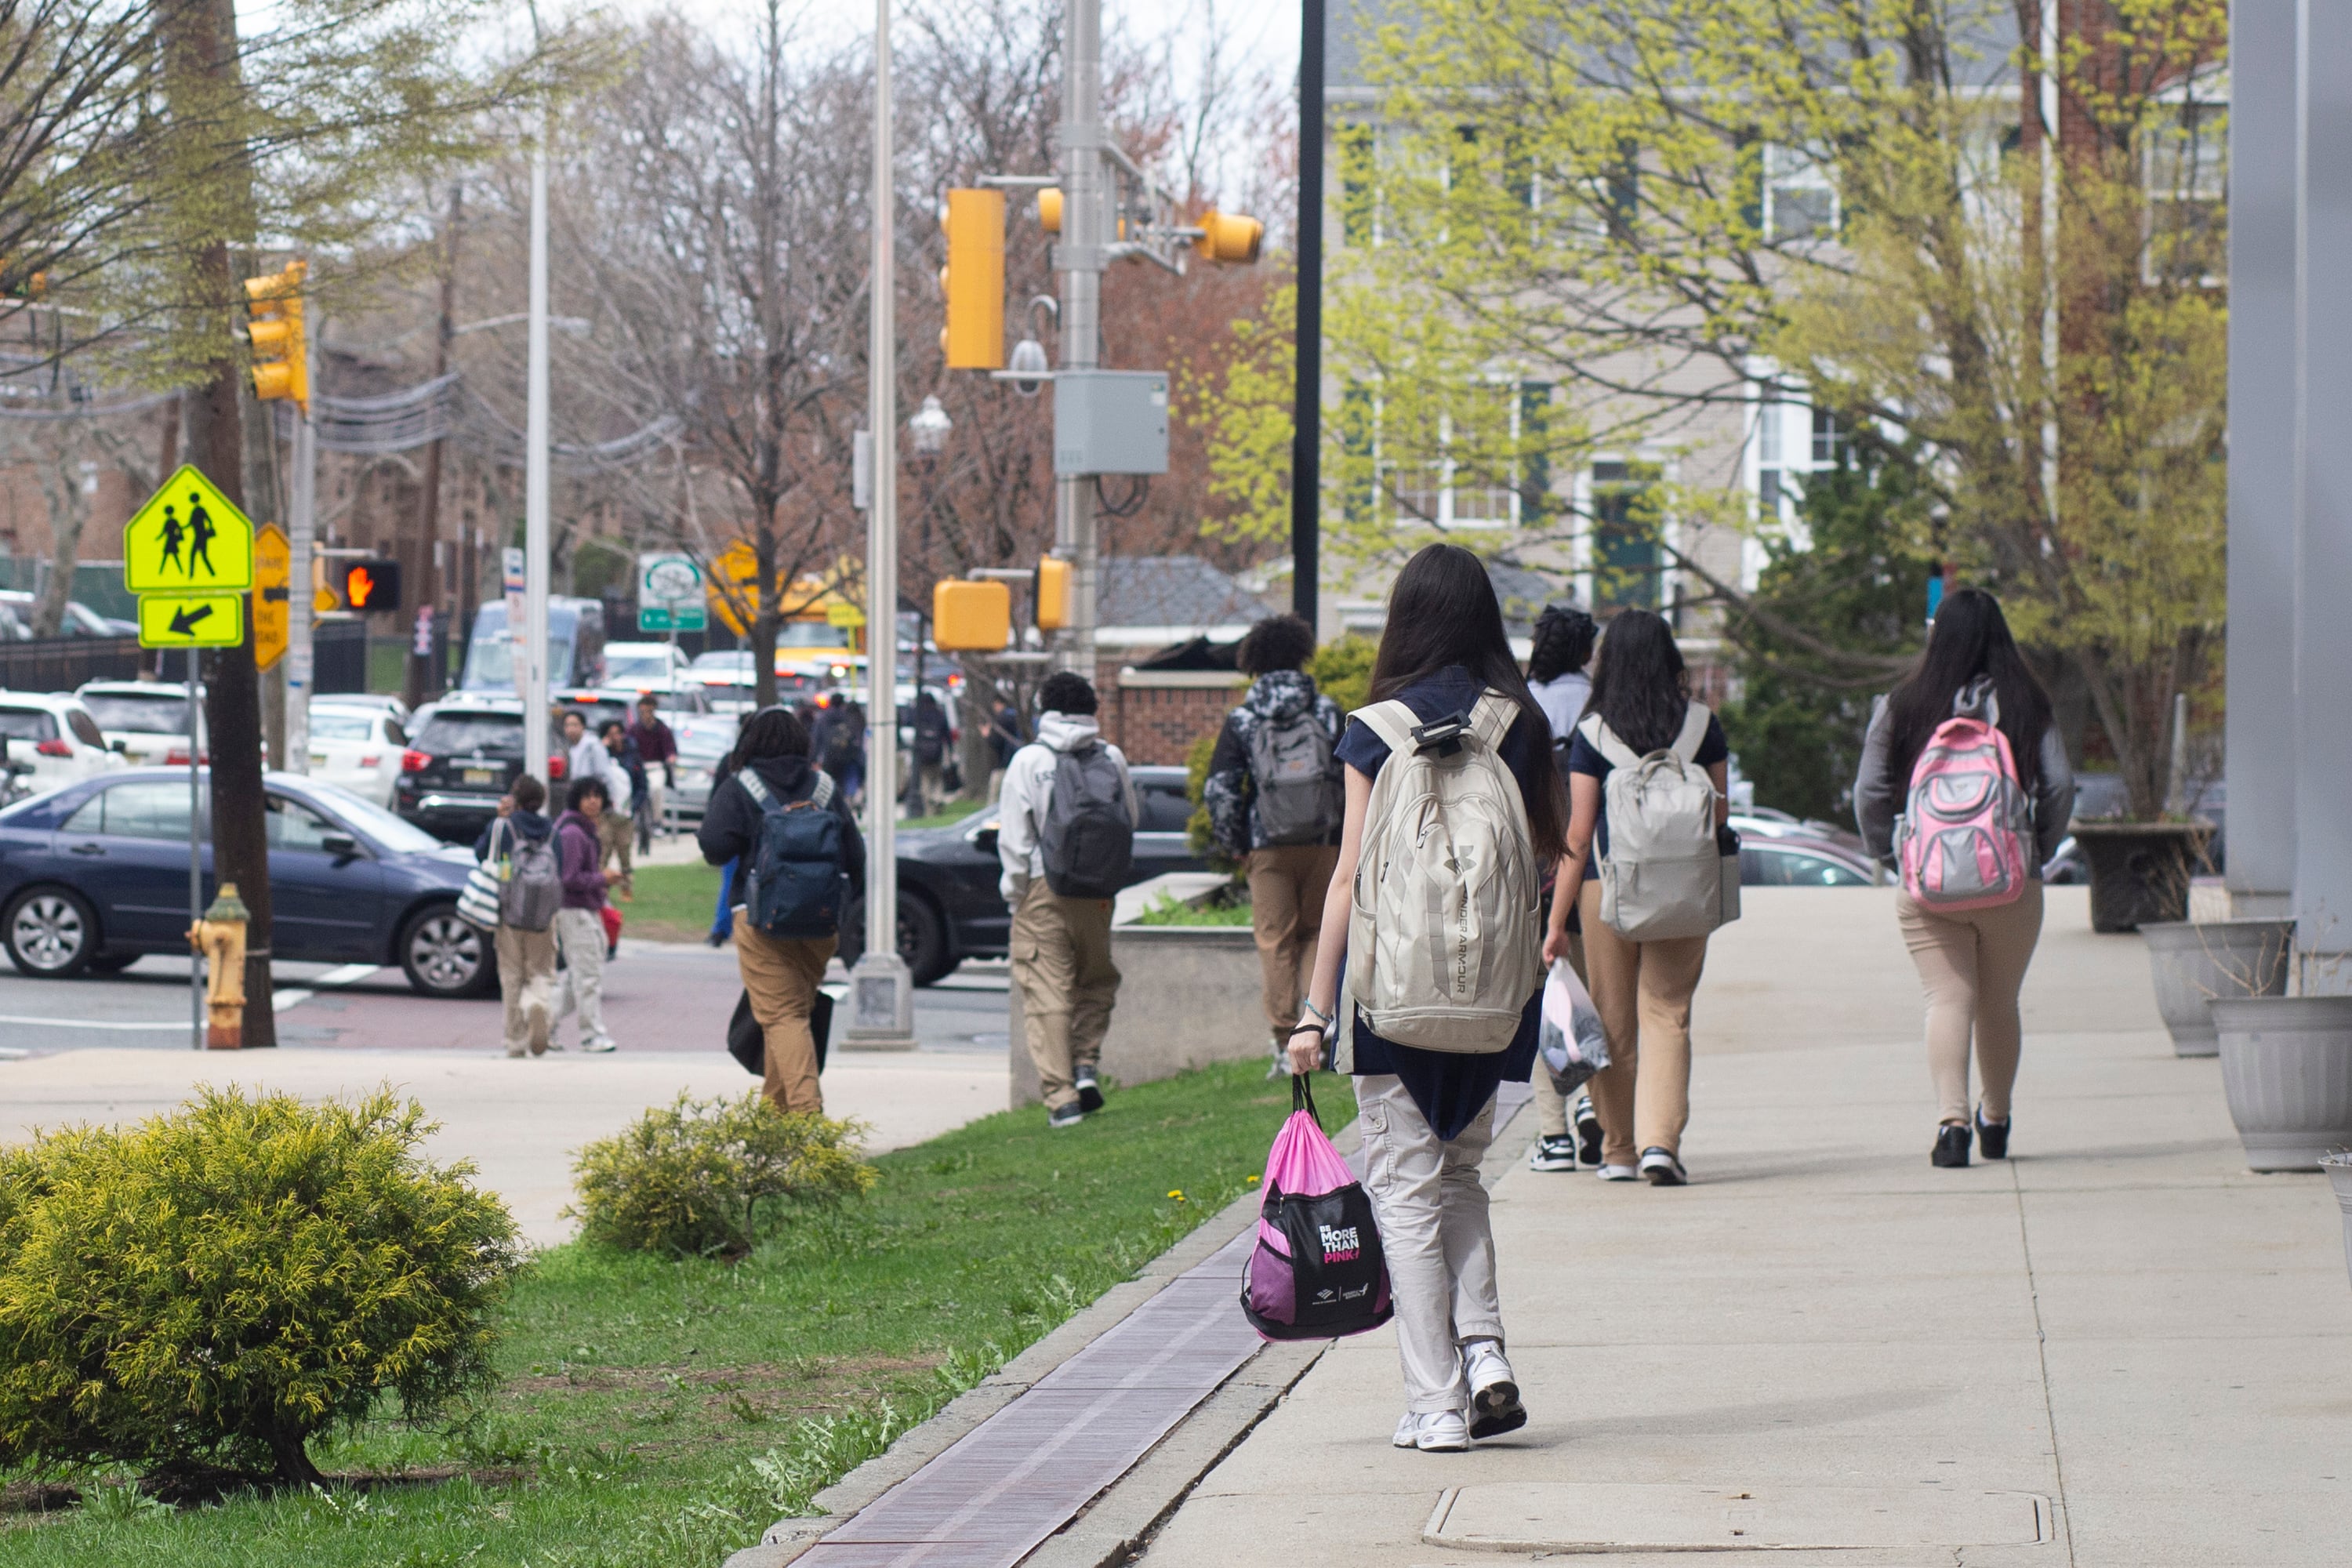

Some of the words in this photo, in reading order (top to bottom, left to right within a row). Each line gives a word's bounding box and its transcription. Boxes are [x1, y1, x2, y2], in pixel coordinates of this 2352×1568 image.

[1459, 890, 1468, 933] UNDER
[1457, 935, 1467, 993] ARMOUR
[1320, 1226, 1358, 1243] MORE
[1322, 1237, 1359, 1253] THAN
